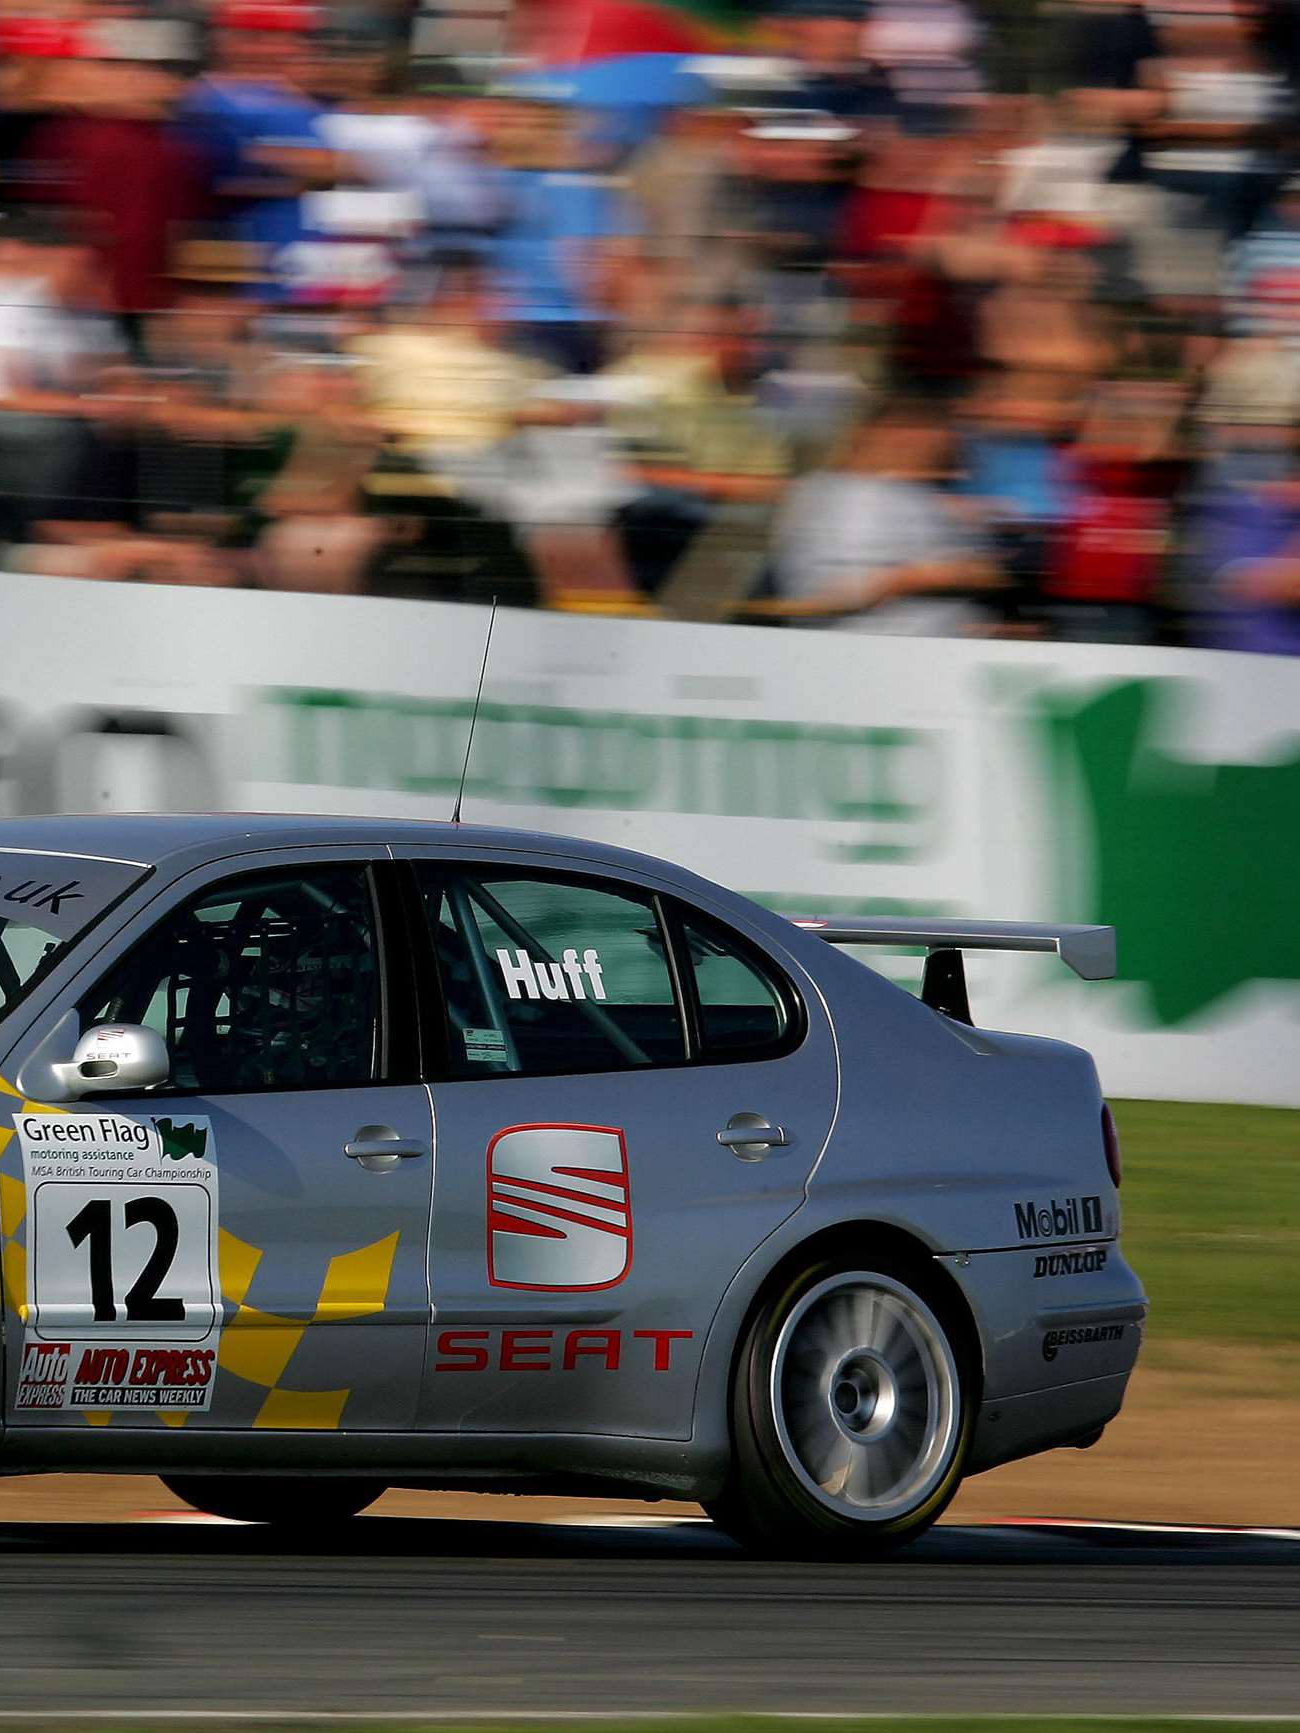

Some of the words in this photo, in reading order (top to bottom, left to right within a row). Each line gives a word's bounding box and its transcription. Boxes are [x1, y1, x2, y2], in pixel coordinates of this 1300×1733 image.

[496, 949, 607, 1003] Huff
[86, 1052, 132, 1060] SEAT
[23, 1118, 95, 1142] Green
[99, 1118, 150, 1150] Flag
[30, 1148, 79, 1162] motoring
[82, 1149, 134, 1161] assistance
[31, 1166, 53, 1177] MSA
[56, 1166, 85, 1177] British
[89, 1166, 124, 1180] Touring
[126, 1167, 142, 1178] Car
[145, 1167, 212, 1181] Championship
[1014, 1198, 1080, 1240] Mobil
[65, 1196, 186, 1322] 12
[1033, 1250, 1108, 1278] DUNLOP
[21, 1346, 69, 1384] Auto
[435, 1329, 693, 1371] SEAT
[74, 1349, 129, 1385] AUTO
[129, 1349, 215, 1387] EXPRESS
[18, 1383, 66, 1406] EXPRESS
[74, 1389, 96, 1403] THE
[99, 1389, 122, 1403] CAR
[124, 1389, 157, 1404] NEWS
[160, 1390, 204, 1405] WEEKLY
